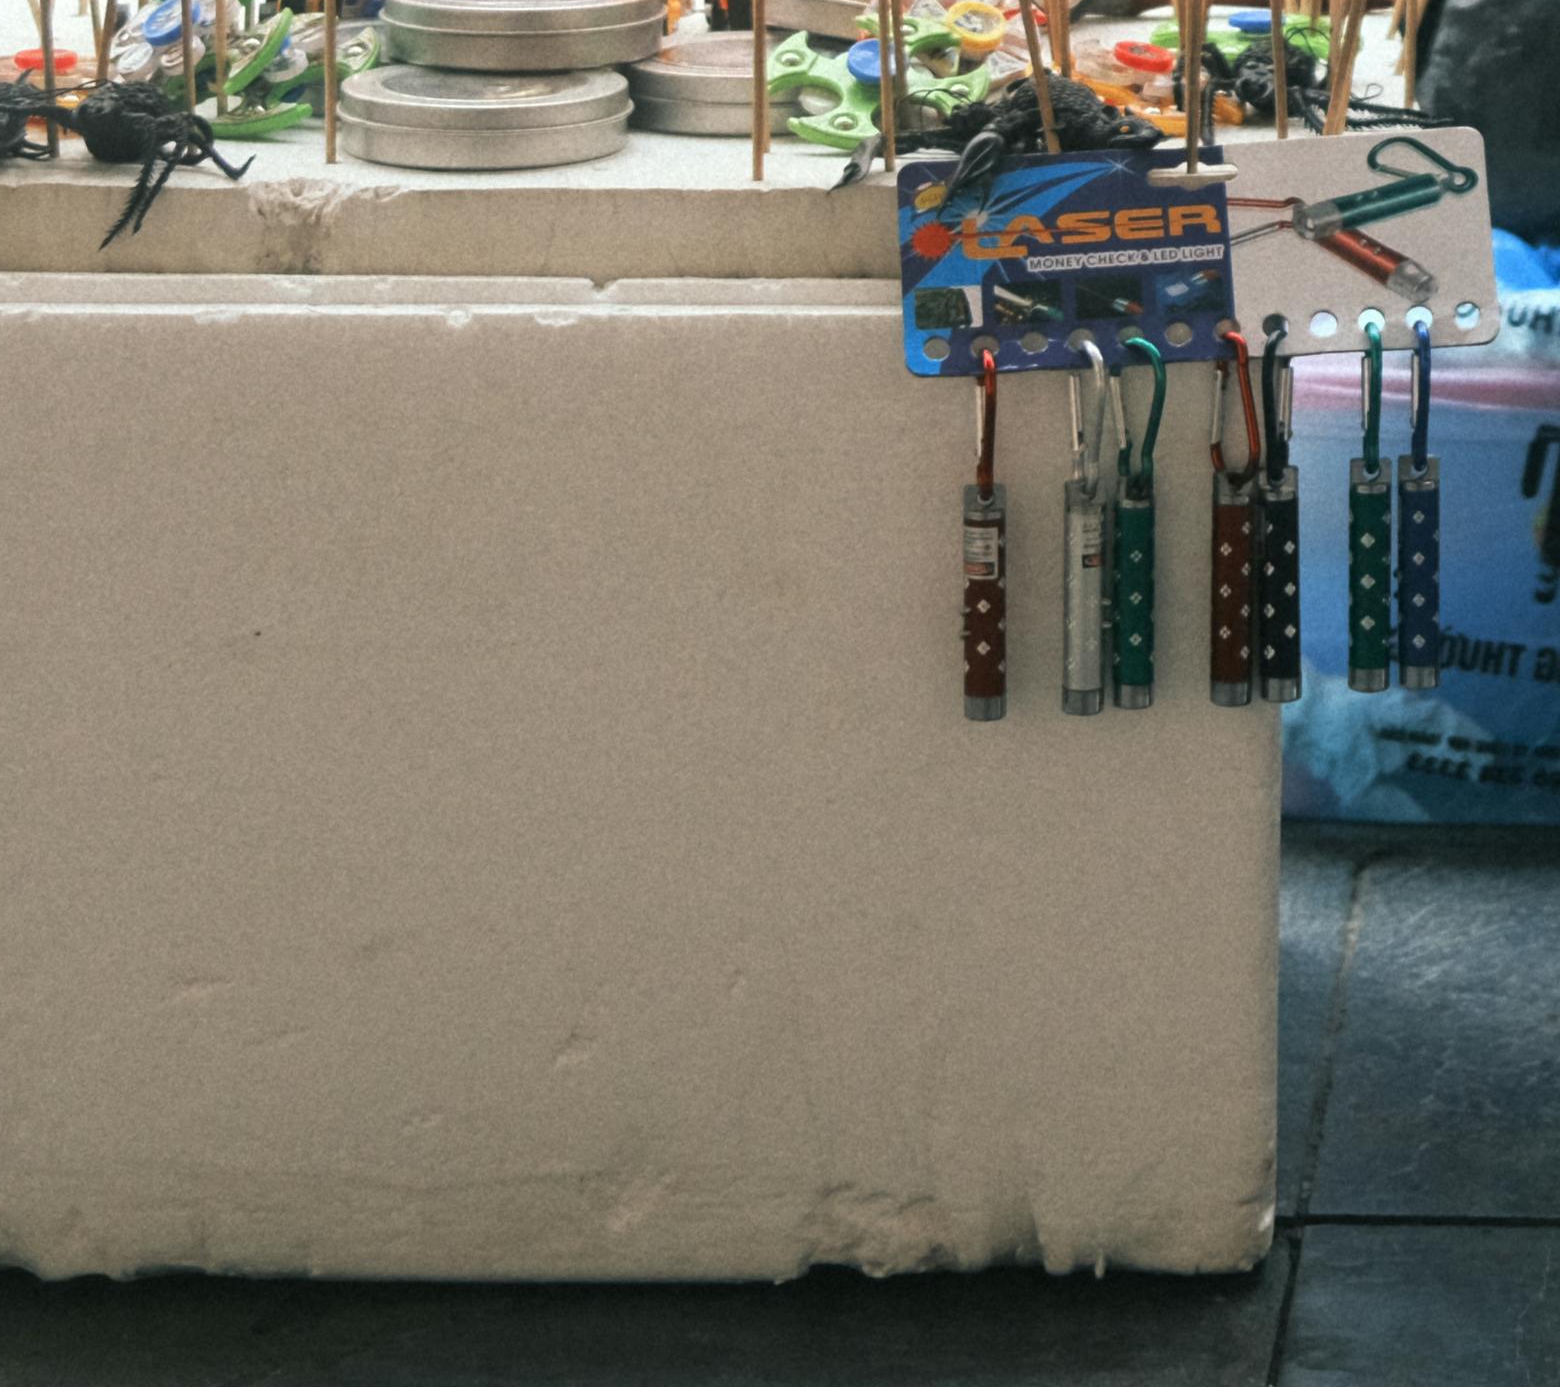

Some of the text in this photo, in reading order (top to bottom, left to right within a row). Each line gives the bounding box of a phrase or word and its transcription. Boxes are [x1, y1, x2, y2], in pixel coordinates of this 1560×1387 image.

[961, 204, 1221, 259] LASER
[1029, 246, 1224, 270] MONEY CHECK & LED LIGHT
